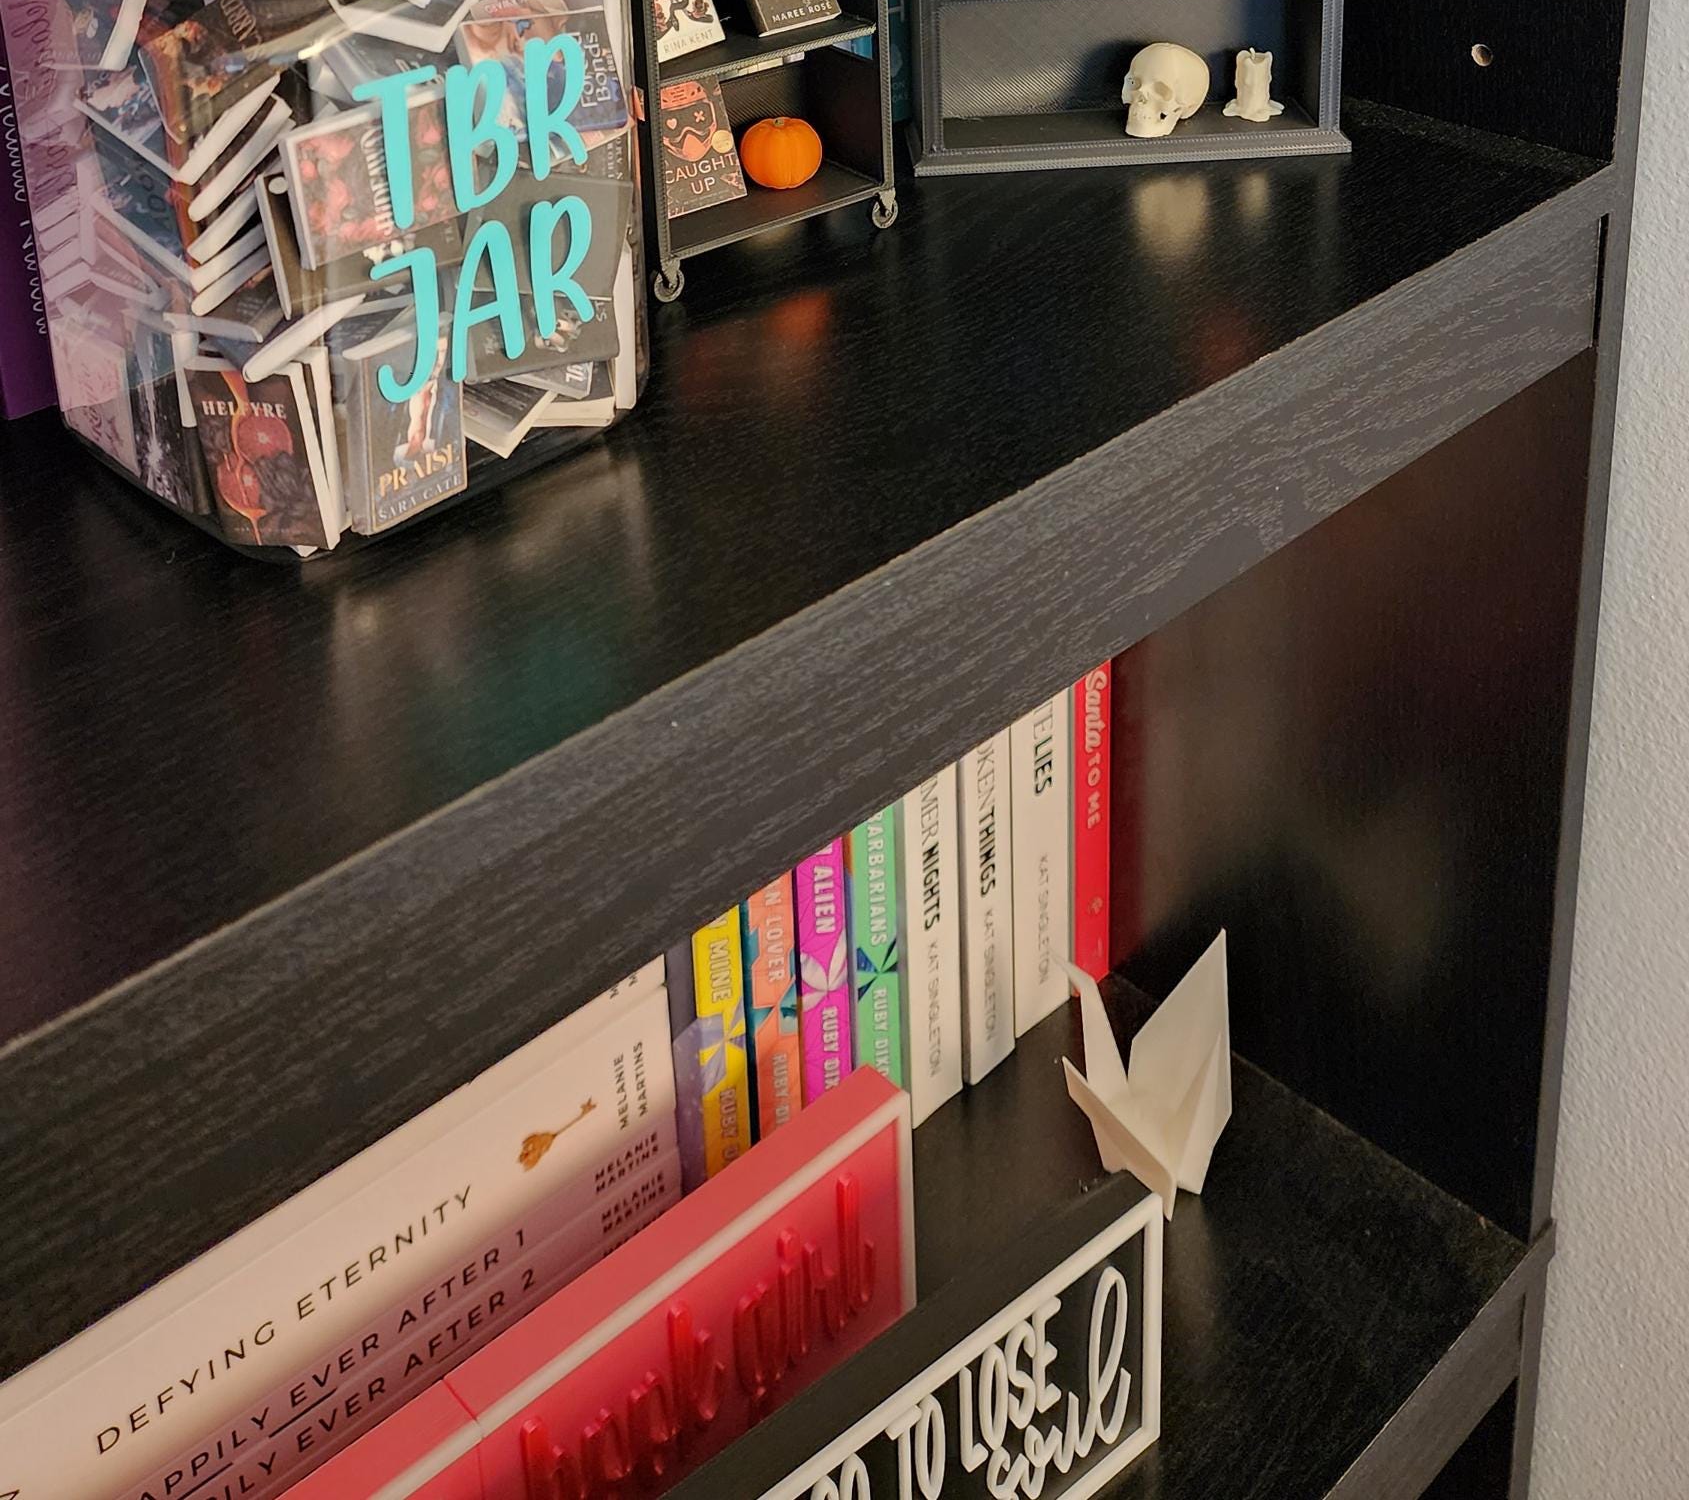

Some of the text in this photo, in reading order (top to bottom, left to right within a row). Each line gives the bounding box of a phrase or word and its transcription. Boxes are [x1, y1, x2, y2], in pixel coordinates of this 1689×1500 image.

[689, 30, 714, 45] KENT
[772, 2, 832, 23] MAREE ROSE
[586, 33, 611, 102] Bonds
[352, 33, 589, 229] TBR
[665, 154, 736, 184] CAUGHT
[691, 177, 716, 195] UP
[369, 195, 595, 404] JAR
[1034, 738, 1053, 796] LIES
[1085, 669, 1107, 829] Santa TO ME
[923, 844, 940, 932] NIGHTS
[978, 809, 996, 899] THINGS
[813, 865, 835, 934] ALIEN
[1038, 852, 1052, 986] KAT SINGLETON
[709, 938, 731, 1004] MINE
[765, 916, 785, 984] LOVER
[983, 907, 999, 1042] KAT SINGLETON
[822, 1005, 841, 1089] RUBY DIX
[873, 988, 888, 1034] RUBY
[926, 942, 942, 1079] KAT SINGLETON
[613, 1052, 630, 1131] MELANIE
[633, 1041, 649, 1118] MARTINS
[719, 1086, 737, 1139] RUBY
[772, 1052, 790, 1104] RUBY
[595, 1131, 658, 1182] MELANIE
[596, 1145, 659, 1193] MARTINS
[602, 1172, 664, 1222] MELANIE
[603, 1185, 665, 1234] MARTINS
[96, 1184, 471, 1455] DEFYING ETERNITY
[141, 1406, 272, 1500] APPILY
[290, 1334, 380, 1406] EVER
[398, 1248, 500, 1333] AFTER
[515, 1230, 525, 1247] 1
[298, 1376, 387, 1452] EVER
[404, 1290, 507, 1376] AFTER
[522, 1268, 535, 1292] 2
[986, 1266, 1132, 1500] soul
[885, 1296, 1062, 1500] TO LOSE
